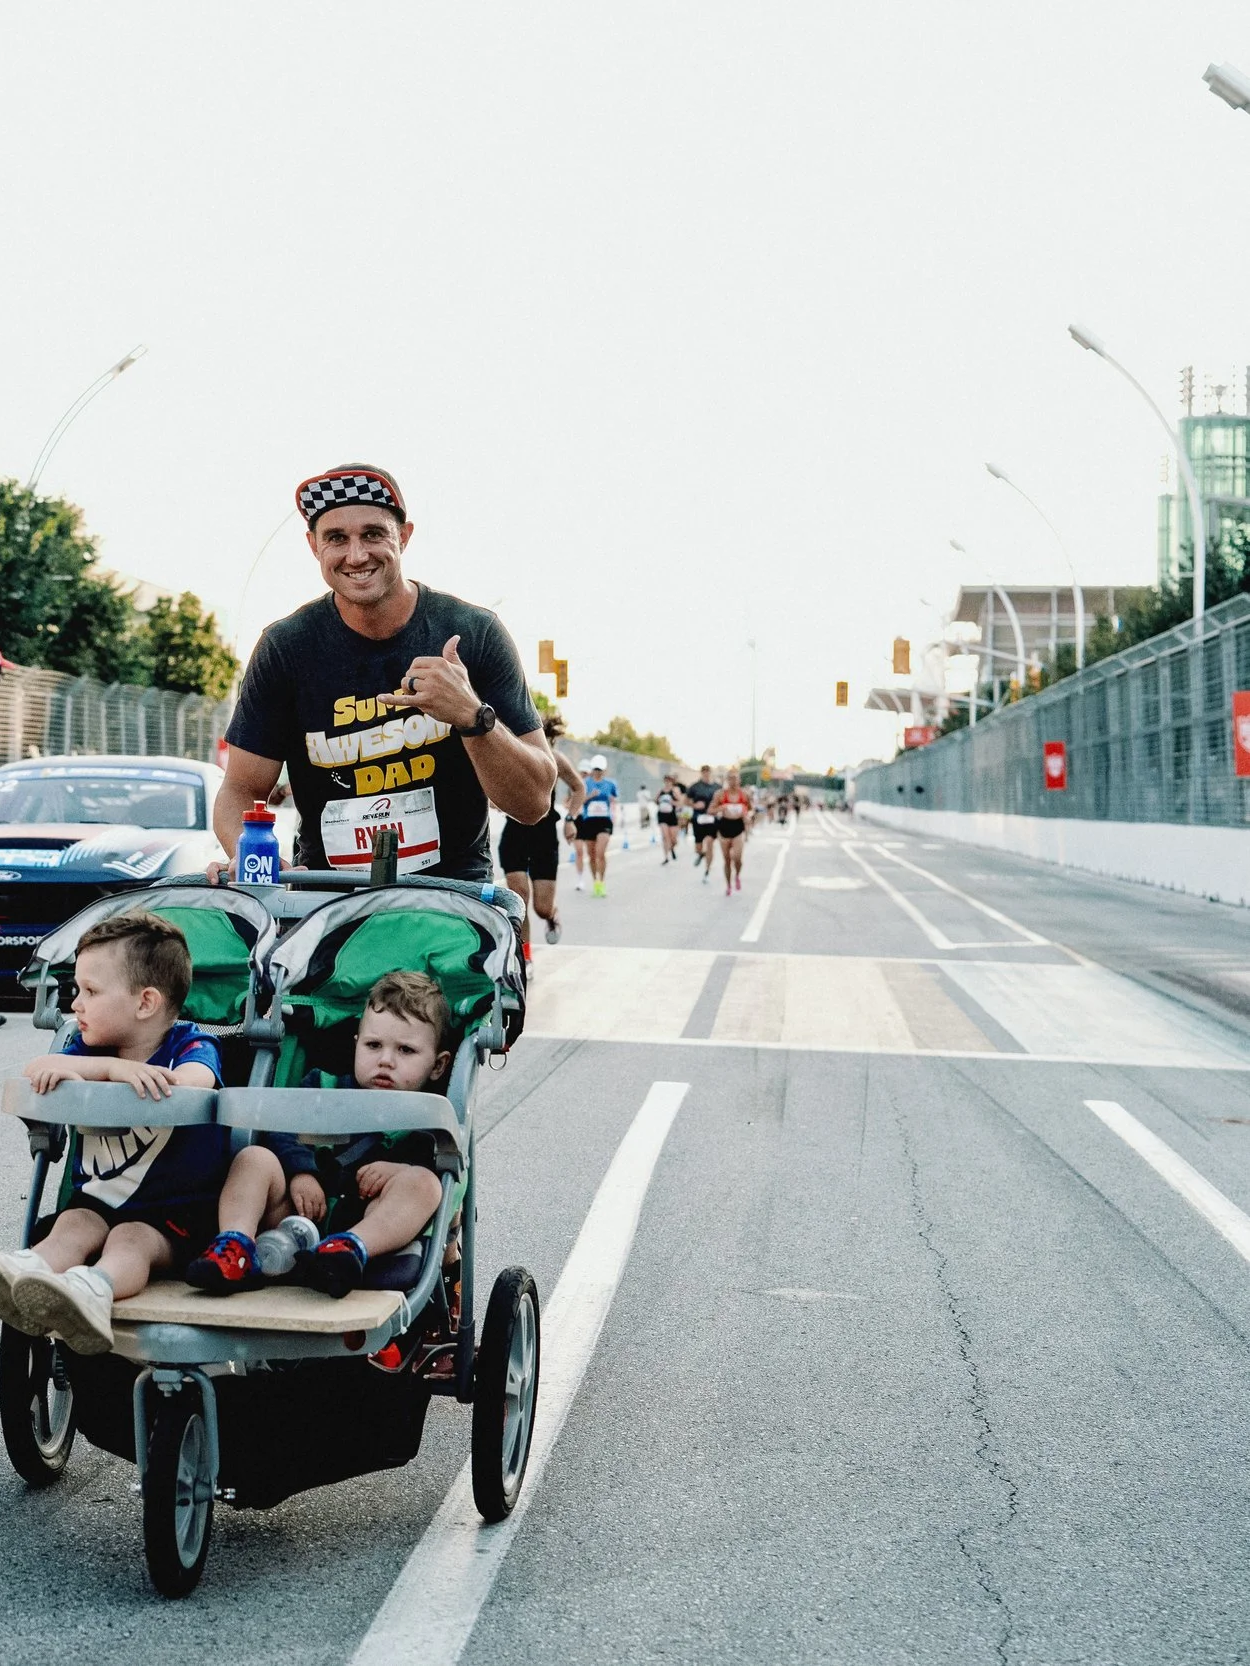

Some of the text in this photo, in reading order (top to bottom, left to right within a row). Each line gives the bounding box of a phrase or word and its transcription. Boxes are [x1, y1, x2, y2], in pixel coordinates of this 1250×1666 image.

[305, 714, 452, 768] AWESOM
[354, 754, 435, 795] DAD
[244, 853, 273, 875] ON
